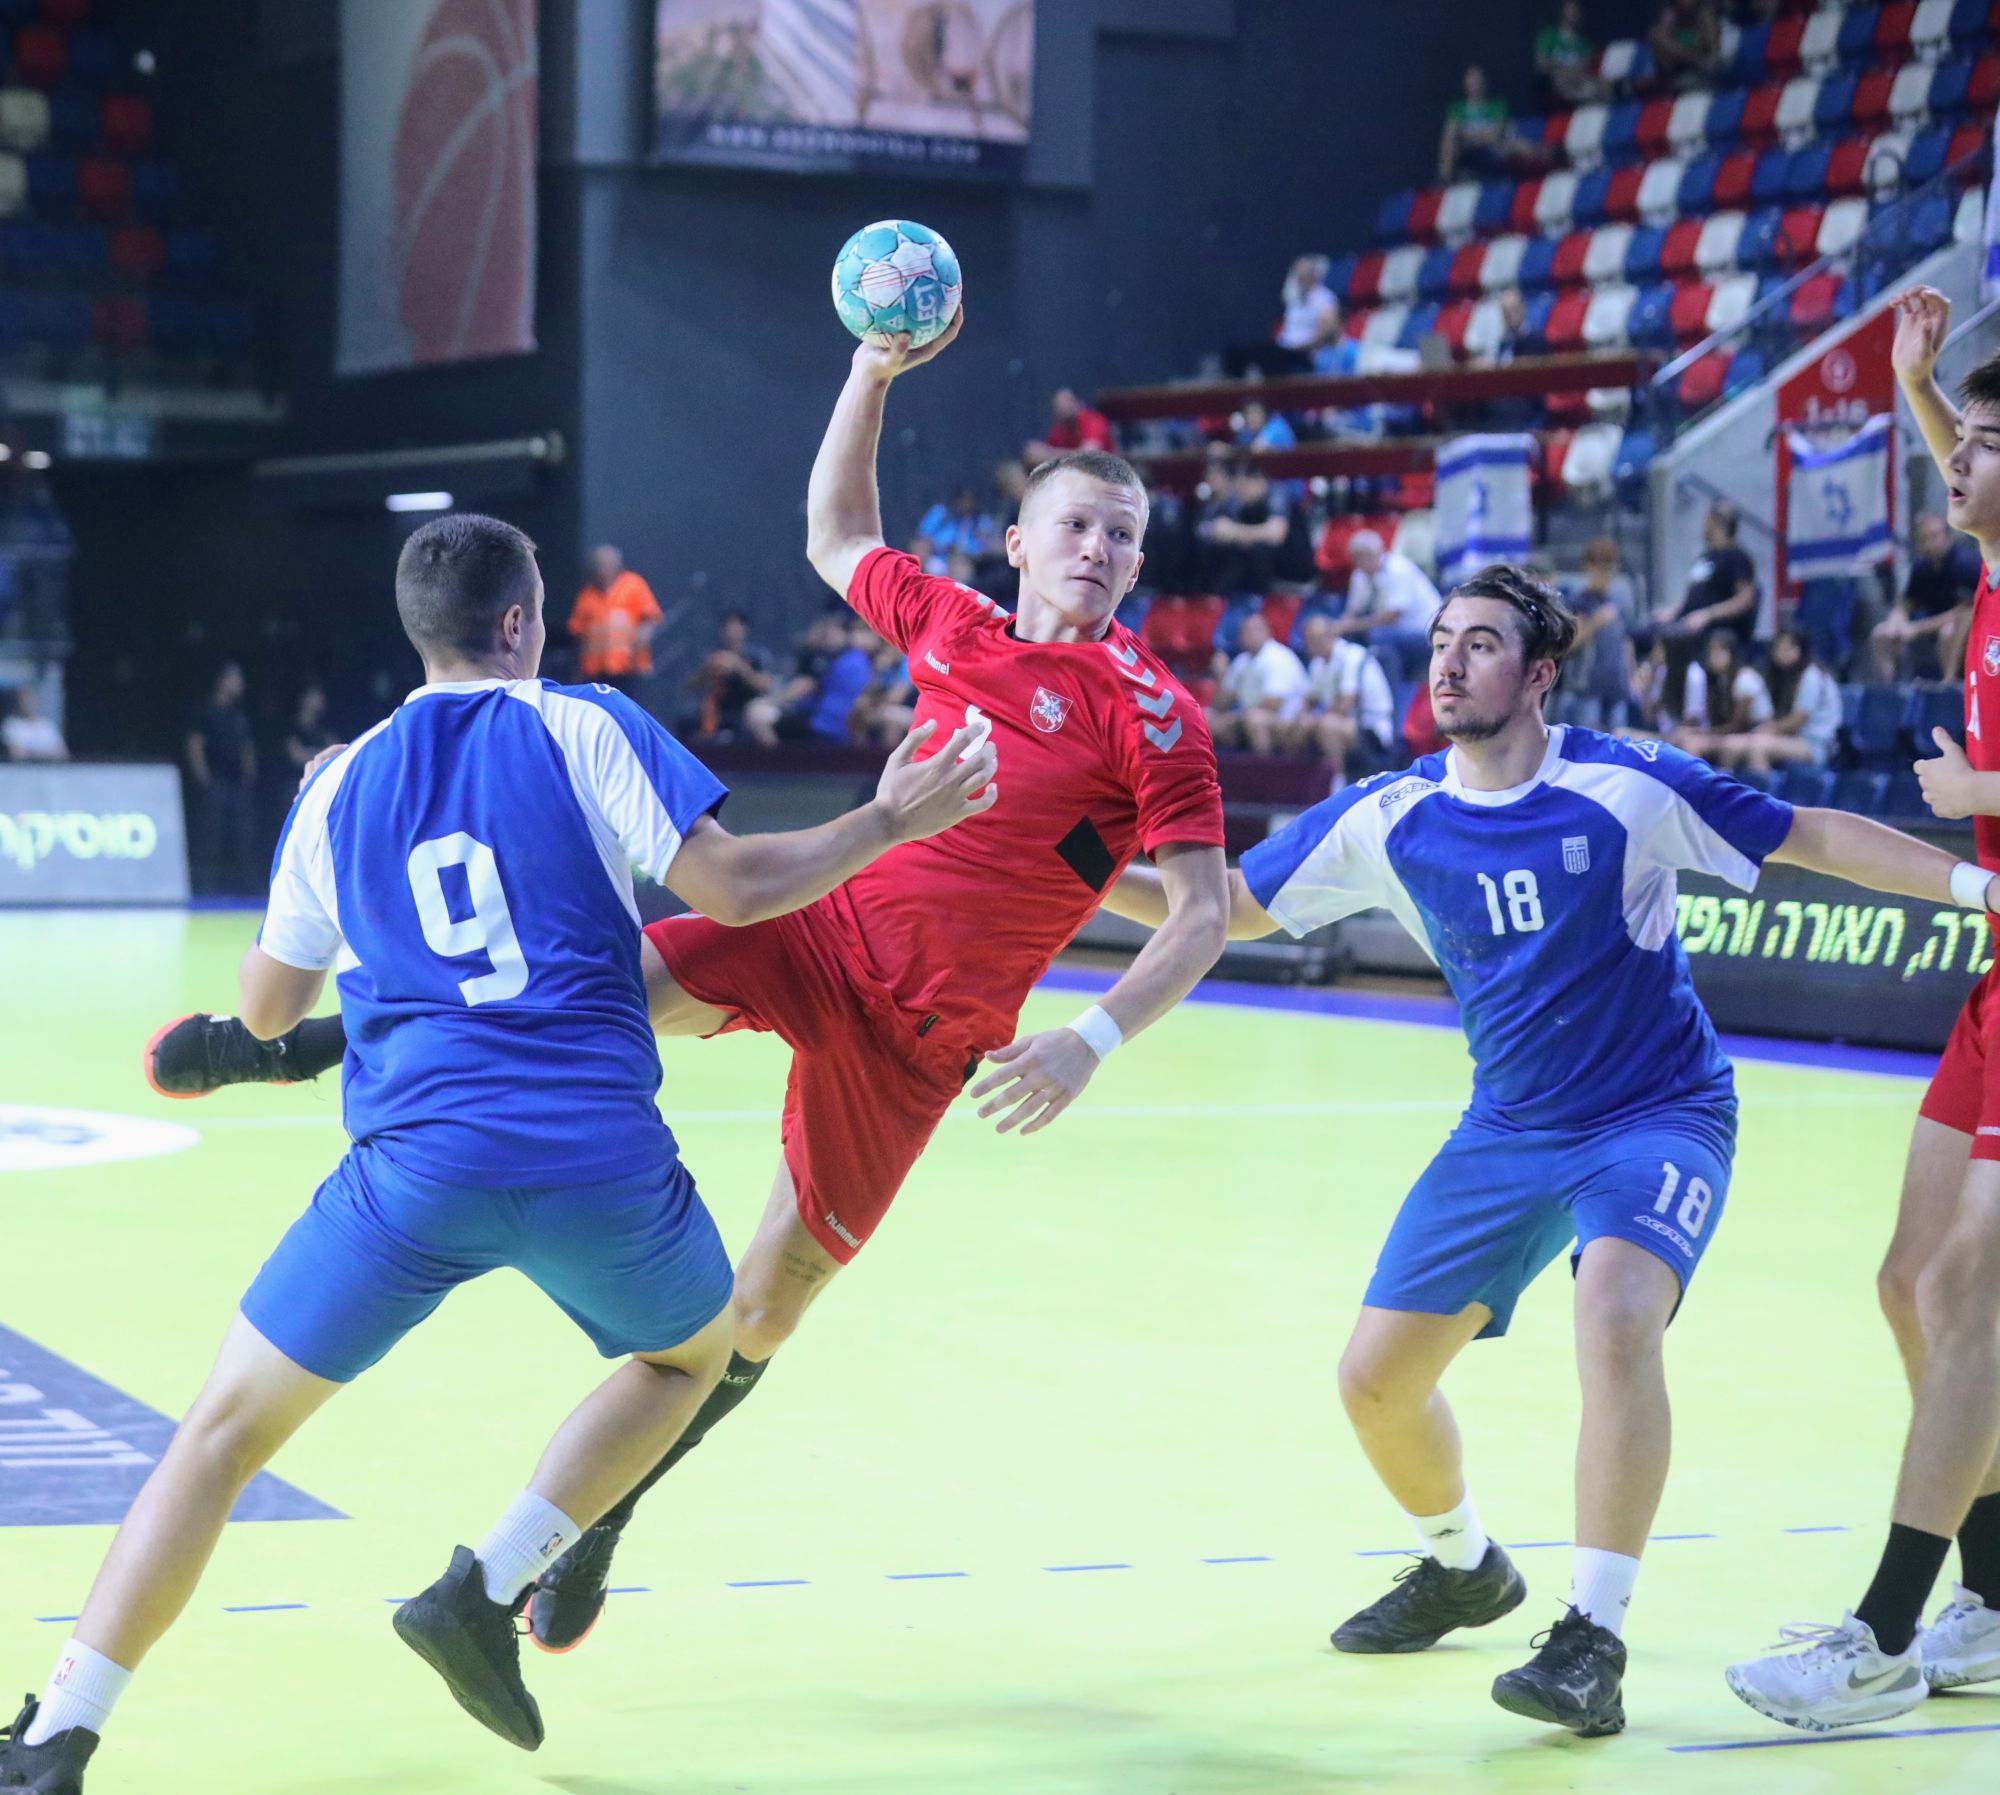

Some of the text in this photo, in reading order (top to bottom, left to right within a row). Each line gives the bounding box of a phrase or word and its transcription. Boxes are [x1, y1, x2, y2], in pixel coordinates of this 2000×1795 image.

[924, 649, 950, 675] hummel
[407, 830, 530, 1008] 9
[1476, 868, 1545, 936] 18
[1763, 901, 1906, 967] תאורה
[824, 1210, 863, 1249] hummel
[1653, 1161, 1712, 1239] 18
